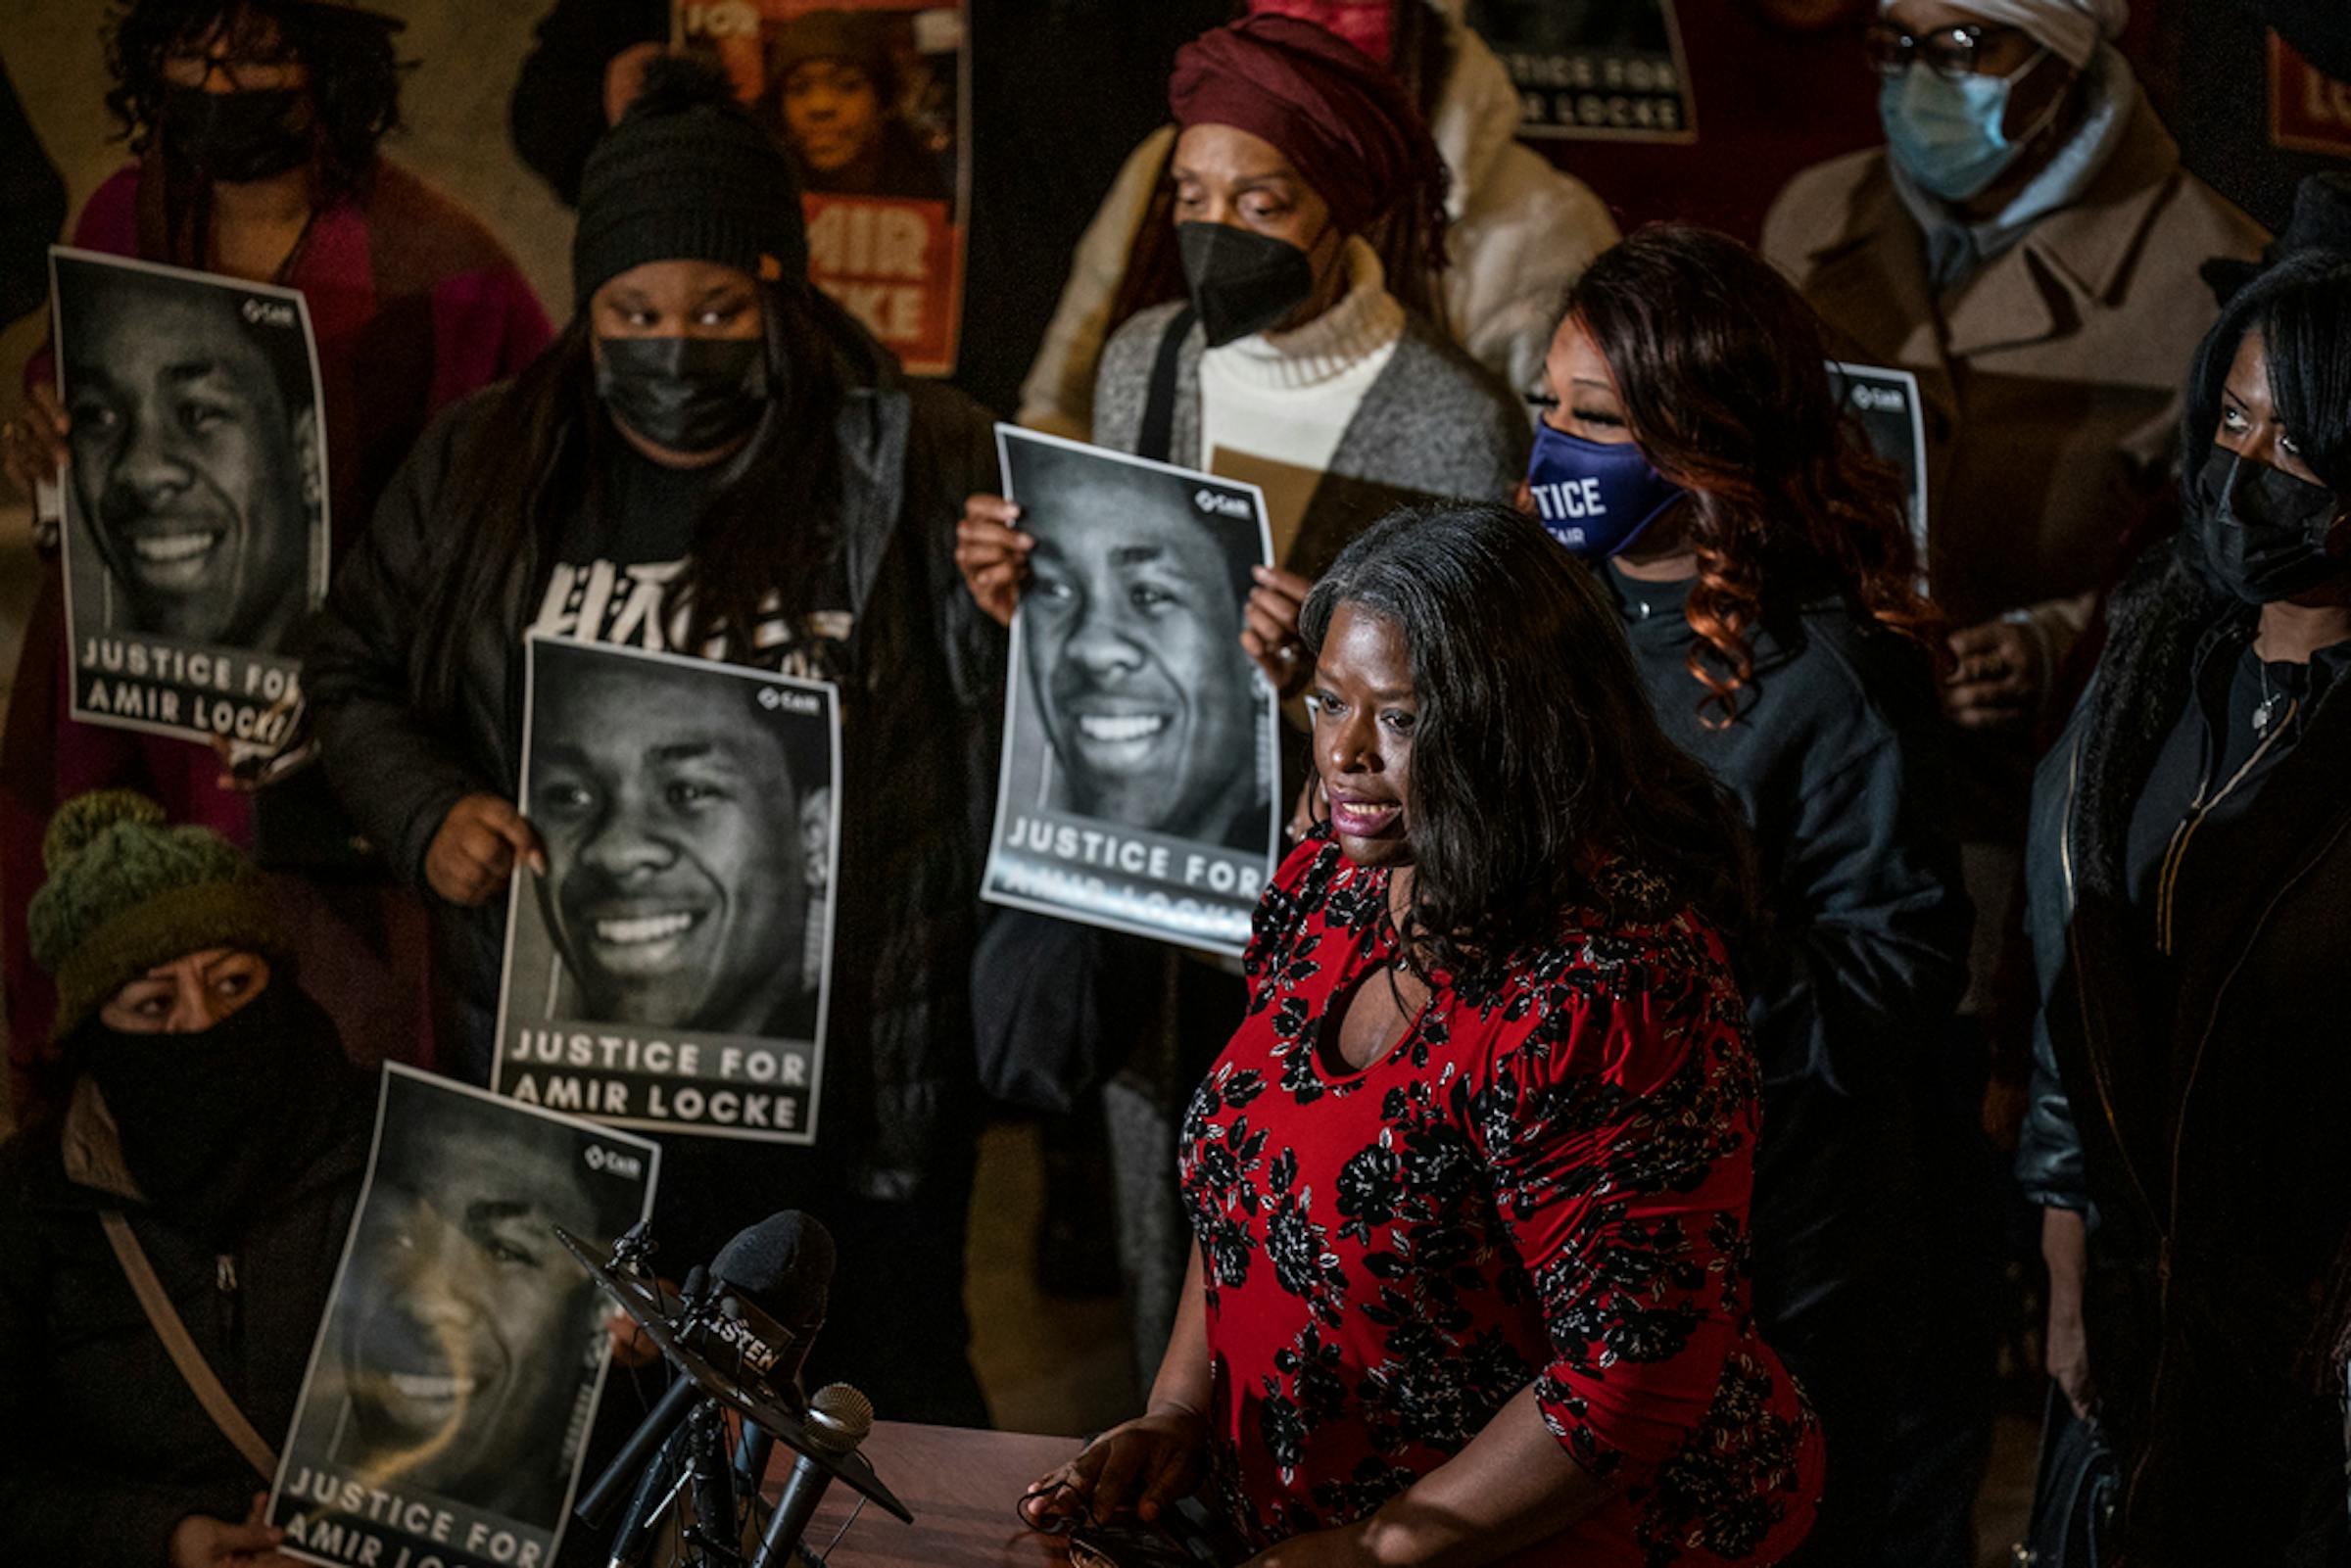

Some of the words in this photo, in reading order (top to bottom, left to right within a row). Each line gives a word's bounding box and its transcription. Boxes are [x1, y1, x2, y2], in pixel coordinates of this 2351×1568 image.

[82, 638, 232, 690] JUSTICE
[88, 679, 180, 724] AMIR
[1007, 816, 1171, 879] JUSTICE
[1185, 854, 1261, 900] FOR
[510, 1029, 700, 1076] JUSTICE
[720, 1046, 806, 1085] FOR
[511, 1072, 629, 1115] AMIR
[648, 1083, 796, 1128] LOCKE
[285, 1512, 384, 1568] AMIR
[288, 1467, 456, 1544] JUSTICE
[465, 1521, 542, 1568] FOR
